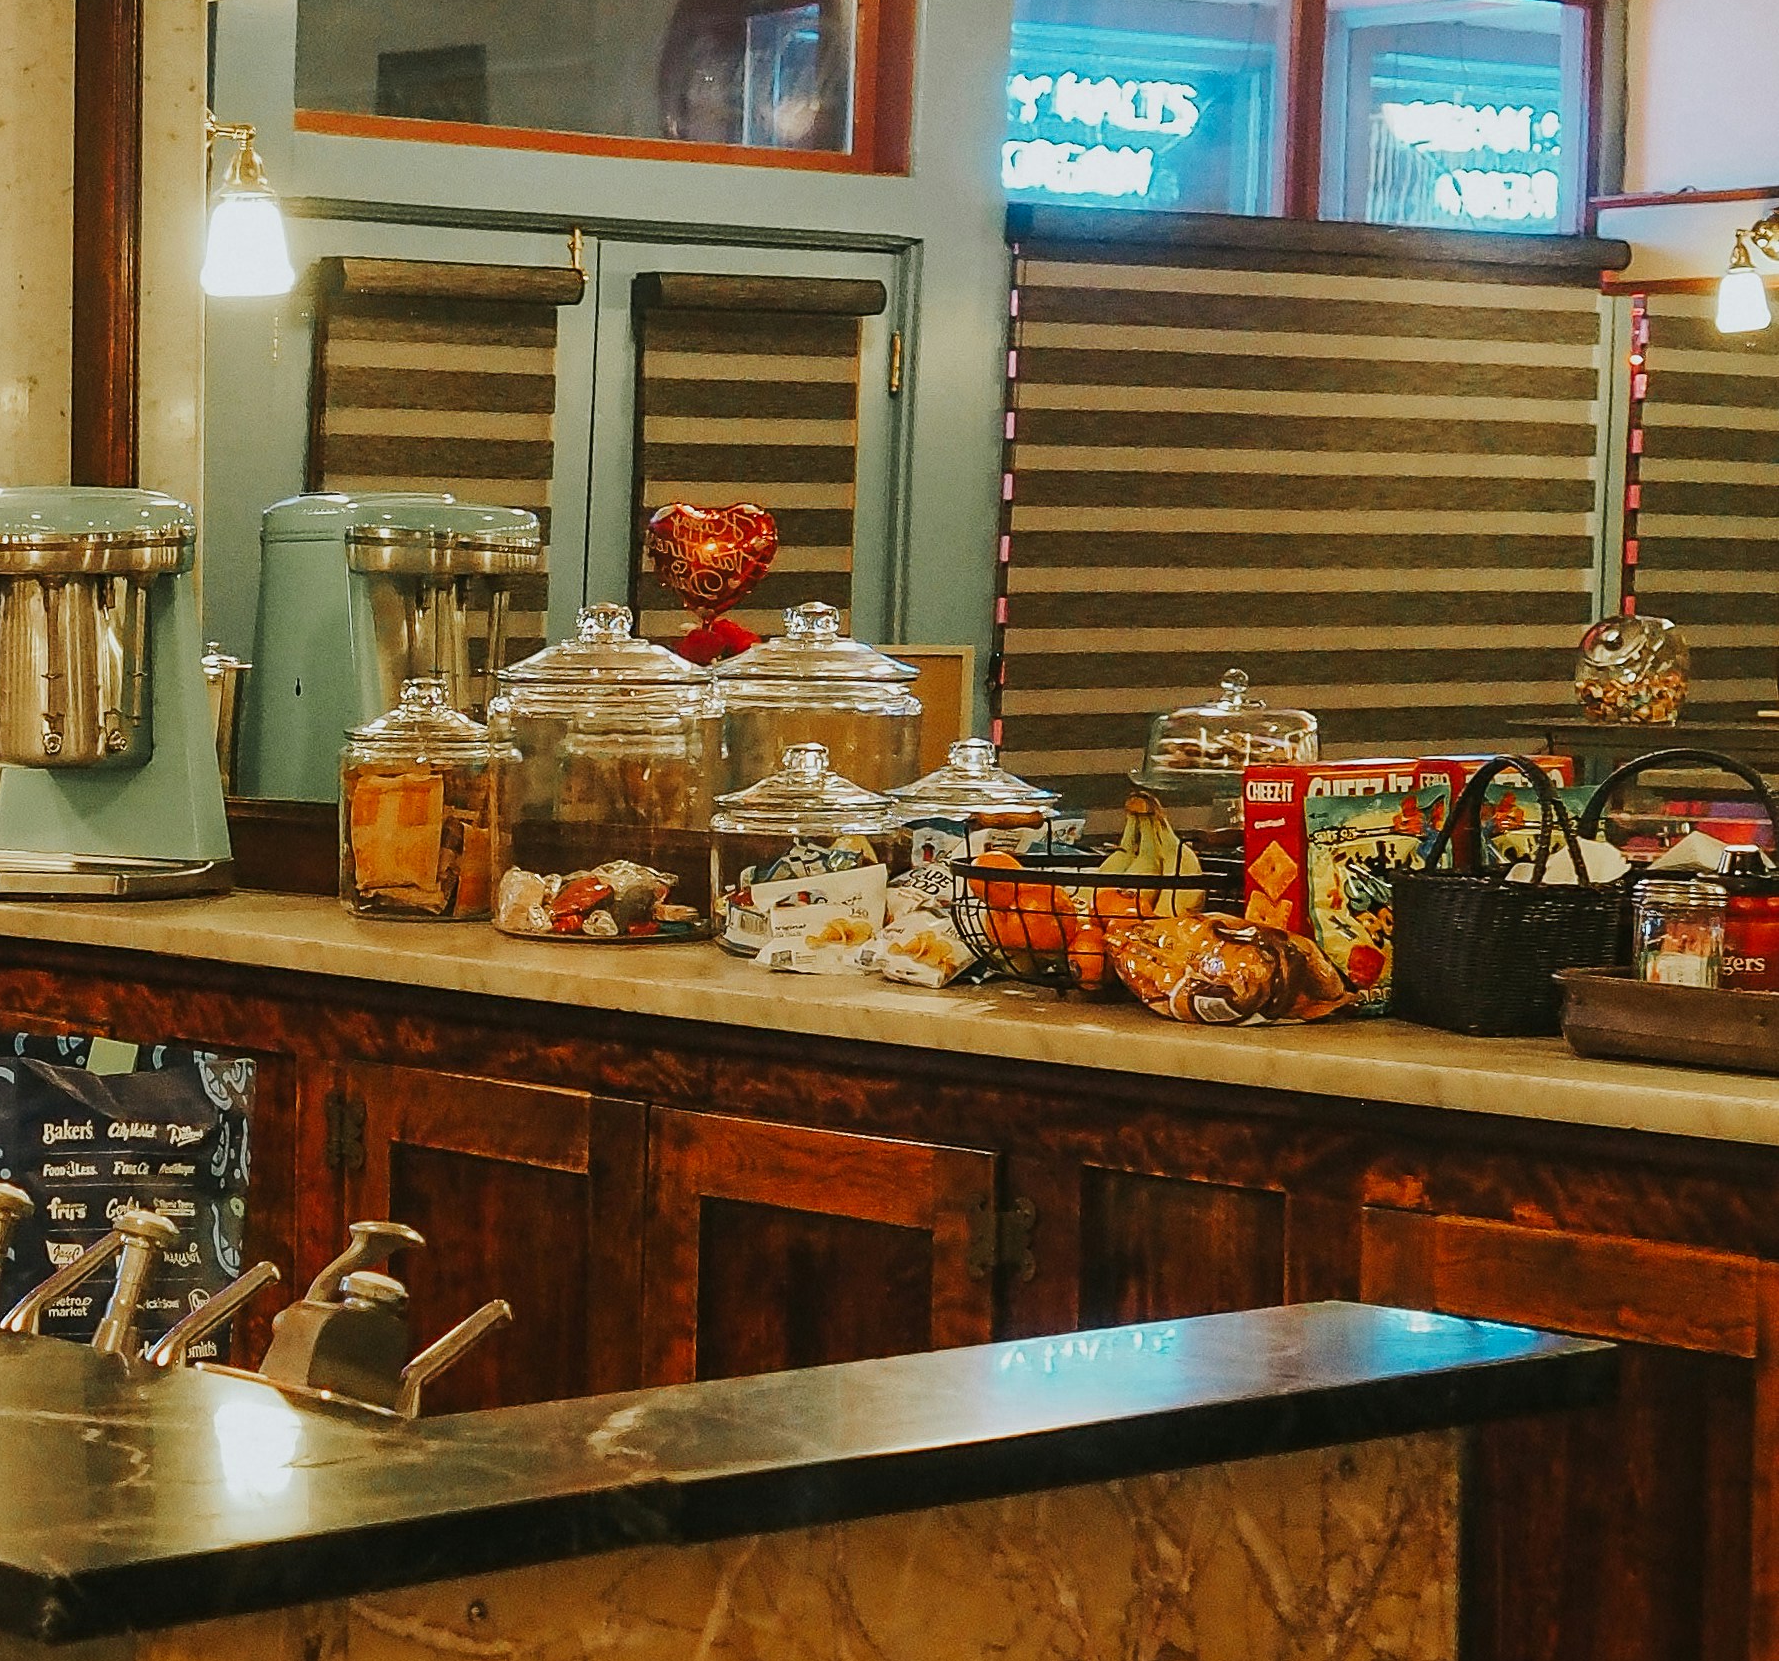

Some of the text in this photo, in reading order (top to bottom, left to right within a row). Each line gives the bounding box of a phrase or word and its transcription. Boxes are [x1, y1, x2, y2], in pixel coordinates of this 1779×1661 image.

[1246, 781, 1295, 803] CHEEZ-IT
[1721, 953, 1766, 977] gers
[42, 1119, 95, 1145] Baker's
[48, 1305, 88, 1318] market
[52, 1296, 82, 1307] etro
